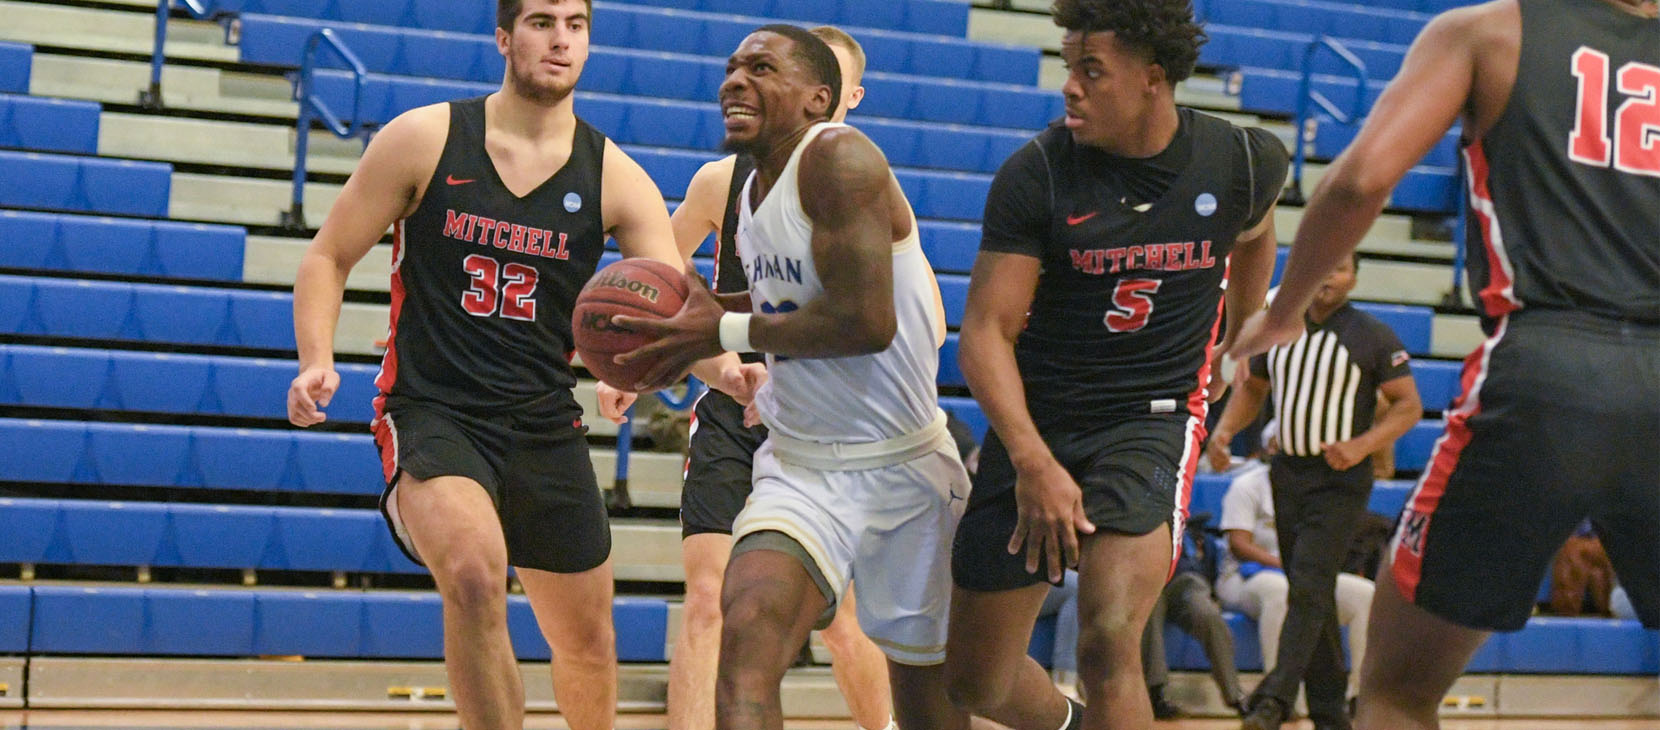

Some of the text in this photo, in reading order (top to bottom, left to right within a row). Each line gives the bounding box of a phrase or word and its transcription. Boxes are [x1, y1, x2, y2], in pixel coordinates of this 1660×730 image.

[1568, 45, 1660, 178] 12
[443, 209, 569, 260] MITCHELL
[1070, 240, 1215, 275] MITCHELL
[461, 254, 539, 322] 32
[1103, 279, 1162, 333] 5
